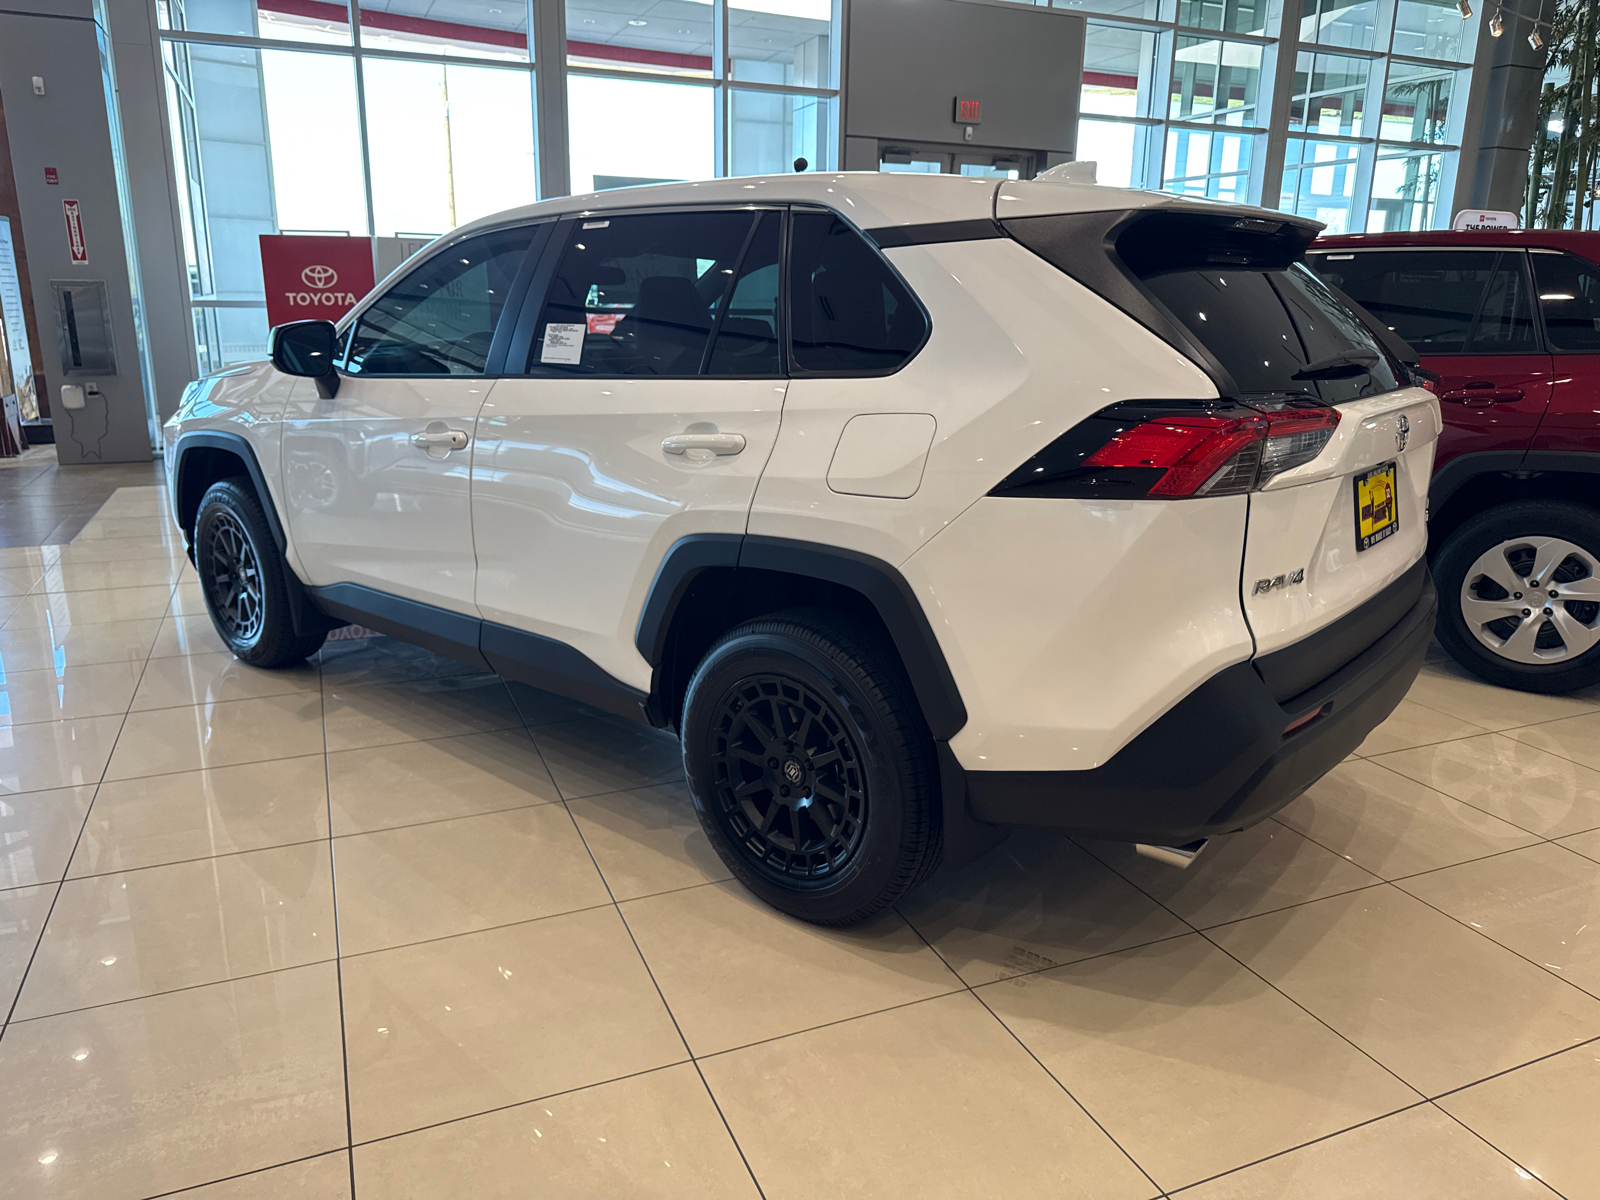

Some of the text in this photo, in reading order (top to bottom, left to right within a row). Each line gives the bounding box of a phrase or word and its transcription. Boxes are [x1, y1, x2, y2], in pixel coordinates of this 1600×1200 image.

[961, 101, 980, 119] EXIT
[285, 292, 358, 306] TOYOTA
[1251, 567, 1304, 597] RAV4
